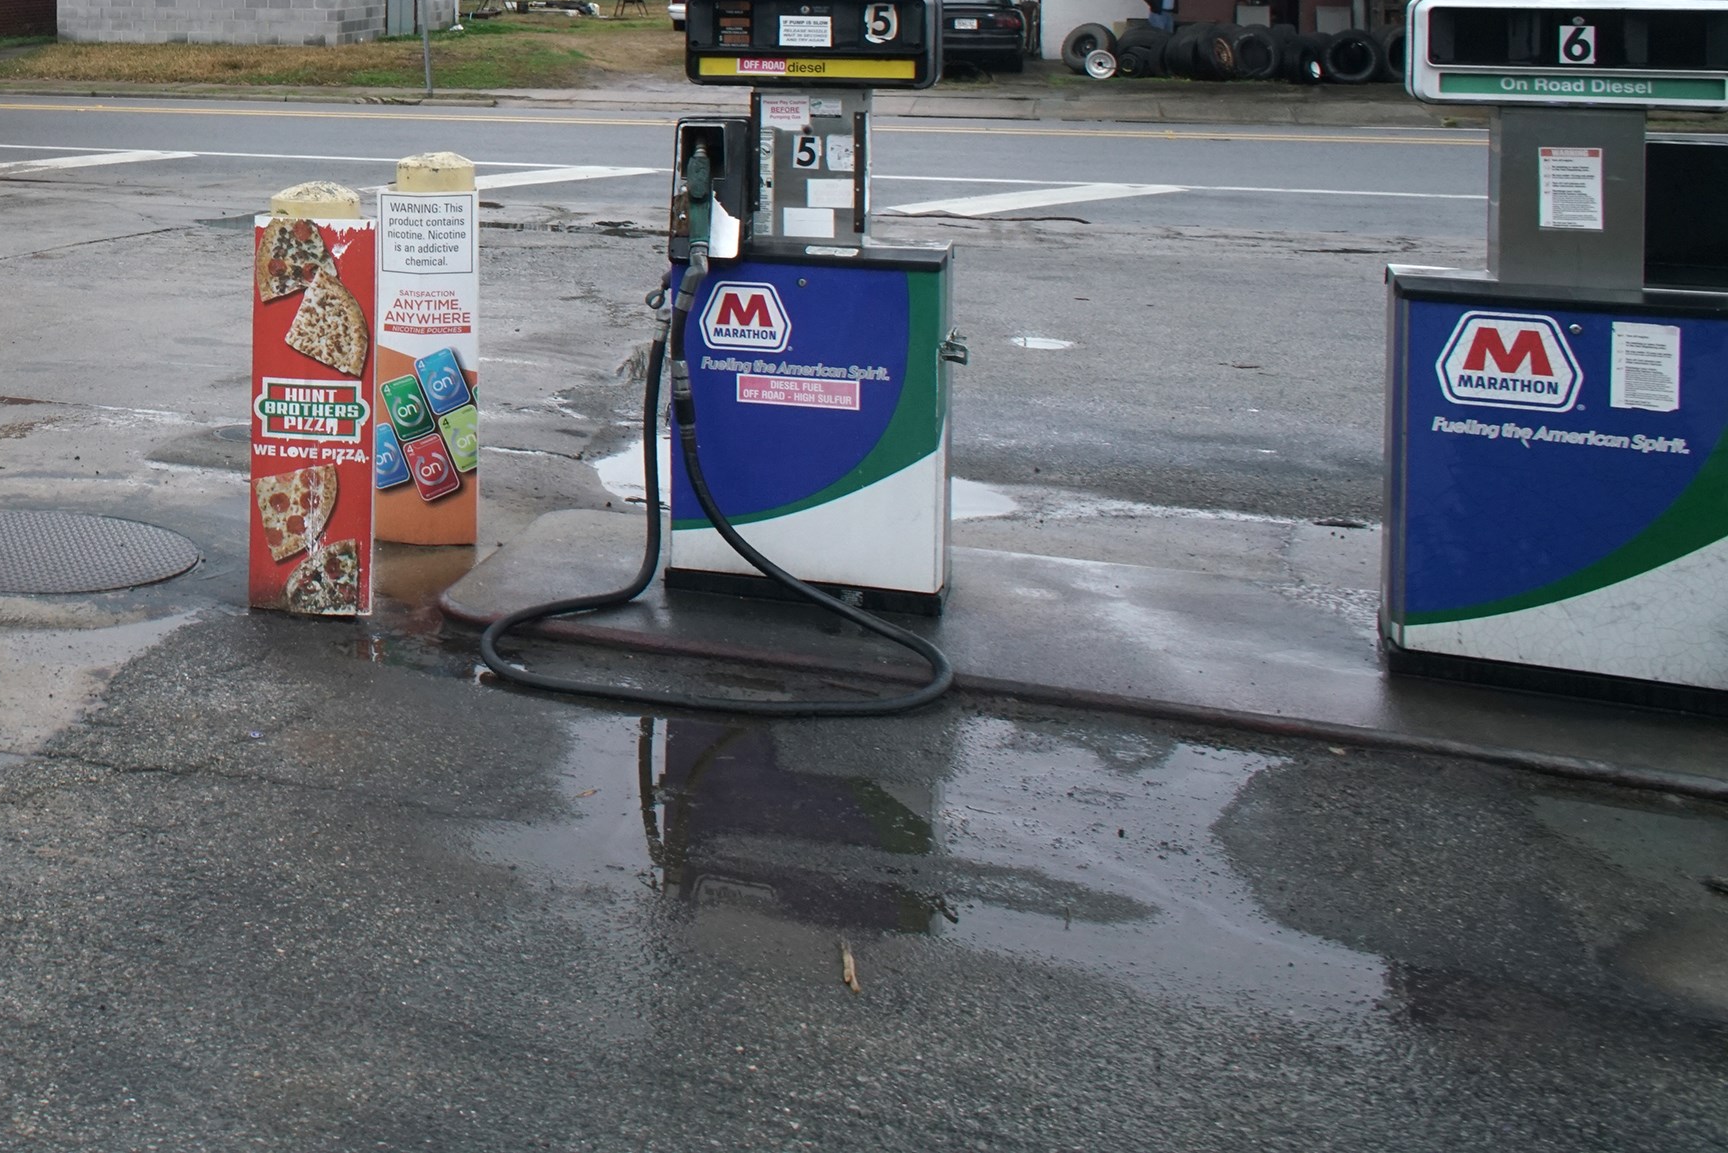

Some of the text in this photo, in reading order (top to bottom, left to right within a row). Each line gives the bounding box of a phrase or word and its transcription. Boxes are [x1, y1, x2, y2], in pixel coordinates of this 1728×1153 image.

[874, 5, 891, 36] 5
[1563, 27, 1592, 62] 6
[743, 59, 826, 73] OFF ROAD diesel
[1500, 77, 1653, 94] On Road Diesel
[796, 137, 816, 167] 5
[390, 202, 463, 214] WARNING: This
[389, 216, 465, 227] product contains
[387, 229, 466, 240] nicotine. Nicotine
[394, 242, 459, 253] is an addictive
[405, 256, 448, 266] chemical.
[399, 289, 455, 298] SATISFACTION
[393, 298, 462, 311] ANYTIME,
[716, 292, 774, 327] M
[384, 310, 471, 324] ANYWHERE
[392, 325, 462, 334] NICOTINE POUCHES
[713, 327, 777, 341] MARATHON
[1462, 326, 1554, 377] M
[701, 356, 753, 374] Fueling
[753, 360, 776, 374] the
[776, 361, 847, 379] American
[432, 376, 453, 392] on
[770, 380, 824, 392] DIESEL FUEL
[1457, 374, 1559, 395] MARATHON
[285, 388, 338, 403] HUNT
[743, 389, 759, 398] OFF
[762, 391, 785, 401] ROAD
[794, 392, 815, 402] HIGH
[817, 394, 852, 405] SULFUR
[264, 401, 359, 418] BROTHERS
[397, 403, 418, 418] on
[1431, 416, 1500, 439] Fueling
[1501, 422, 1532, 440] the
[1533, 426, 1629, 450] American
[253, 444, 276, 456] WE
[280, 446, 318, 459] LOVE
[421, 462, 442, 477] on
